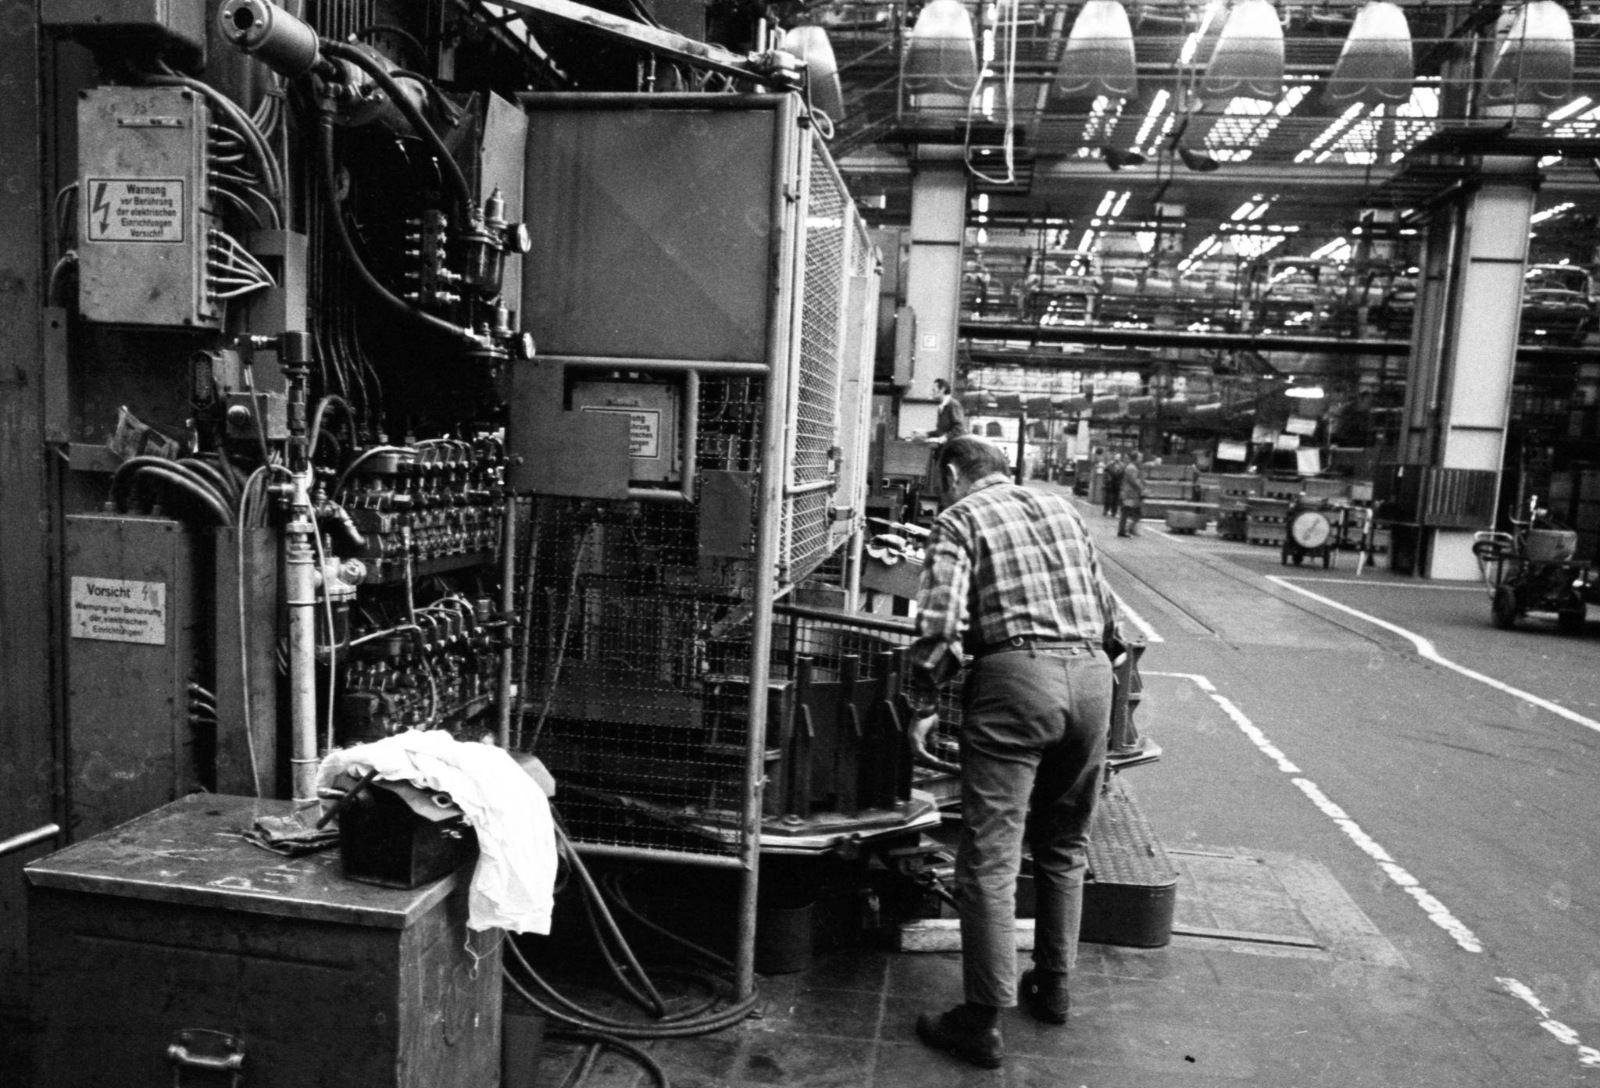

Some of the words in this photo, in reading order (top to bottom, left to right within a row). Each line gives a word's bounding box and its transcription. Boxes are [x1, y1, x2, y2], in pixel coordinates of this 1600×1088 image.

[126, 184, 166, 197] Warnung
[116, 207, 129, 216] der
[130, 208, 176, 216] elektrischen
[121, 217, 172, 229] Einrichtungen
[86, 583, 131, 598] Vorsicht
[75, 601, 108, 614] Warnung
